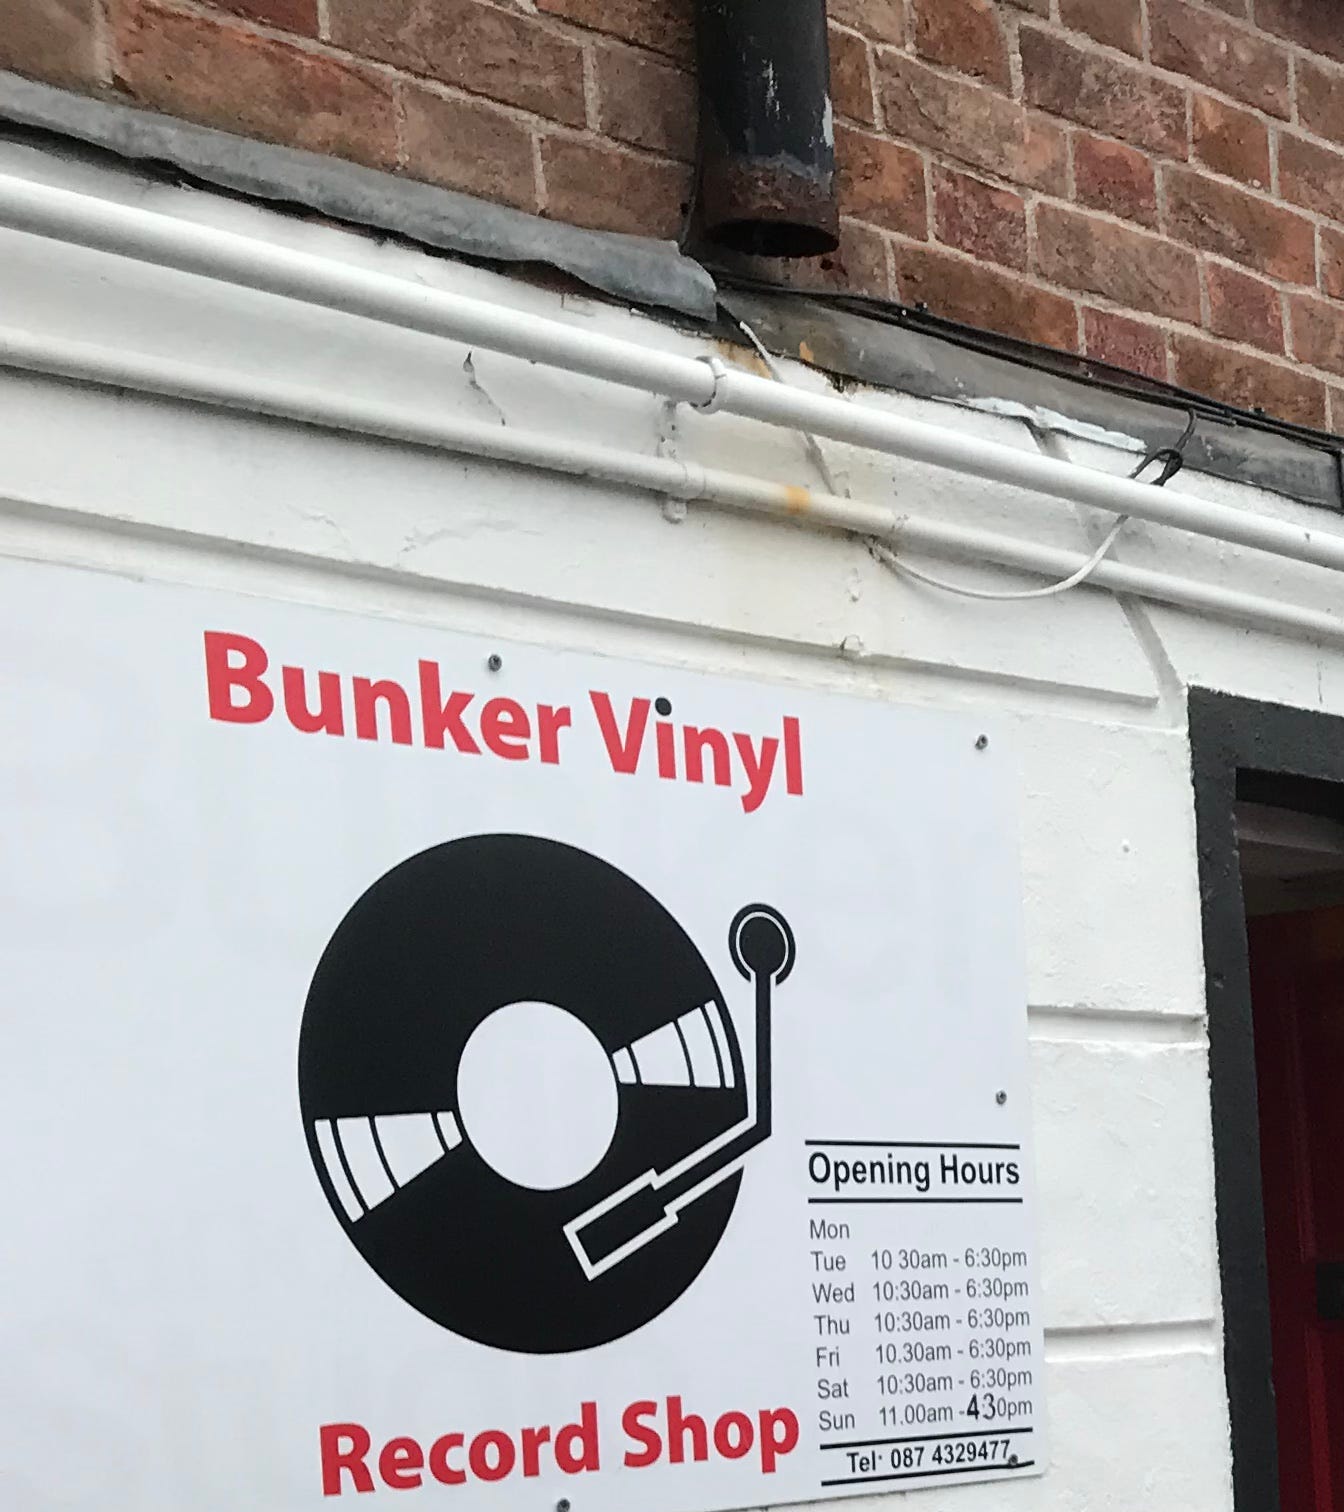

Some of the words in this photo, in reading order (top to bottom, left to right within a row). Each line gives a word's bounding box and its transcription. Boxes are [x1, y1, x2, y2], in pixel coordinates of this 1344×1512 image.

[205, 632, 570, 763] Bunker
[591, 692, 802, 812] Vinyl
[809, 1152, 930, 1192] Opening
[940, 1153, 1020, 1185] Hours
[810, 1219, 849, 1239] Mon
[810, 1251, 846, 1271] Tue
[965, 1248, 1027, 1272] 6:30pm
[812, 1282, 854, 1303] Wed
[873, 1280, 948, 1301] 10:30am
[967, 1278, 1028, 1301] 6:30pm
[814, 1315, 849, 1335] Thu
[875, 1311, 950, 1332] 10:30am
[968, 1308, 1030, 1331] 6:30pm
[817, 1346, 839, 1367] Fri
[969, 1338, 1031, 1361] 6:30pm
[818, 1379, 849, 1400] Sat
[878, 1373, 952, 1395] 10:30am
[970, 1368, 1032, 1391] 6:30pm
[819, 1410, 855, 1431] Sun
[321, 1403, 599, 1495] Record
[623, 1397, 798, 1472] Shop
[891, 1446, 925, 1469] 087
[932, 1440, 1010, 1465] 4329477
